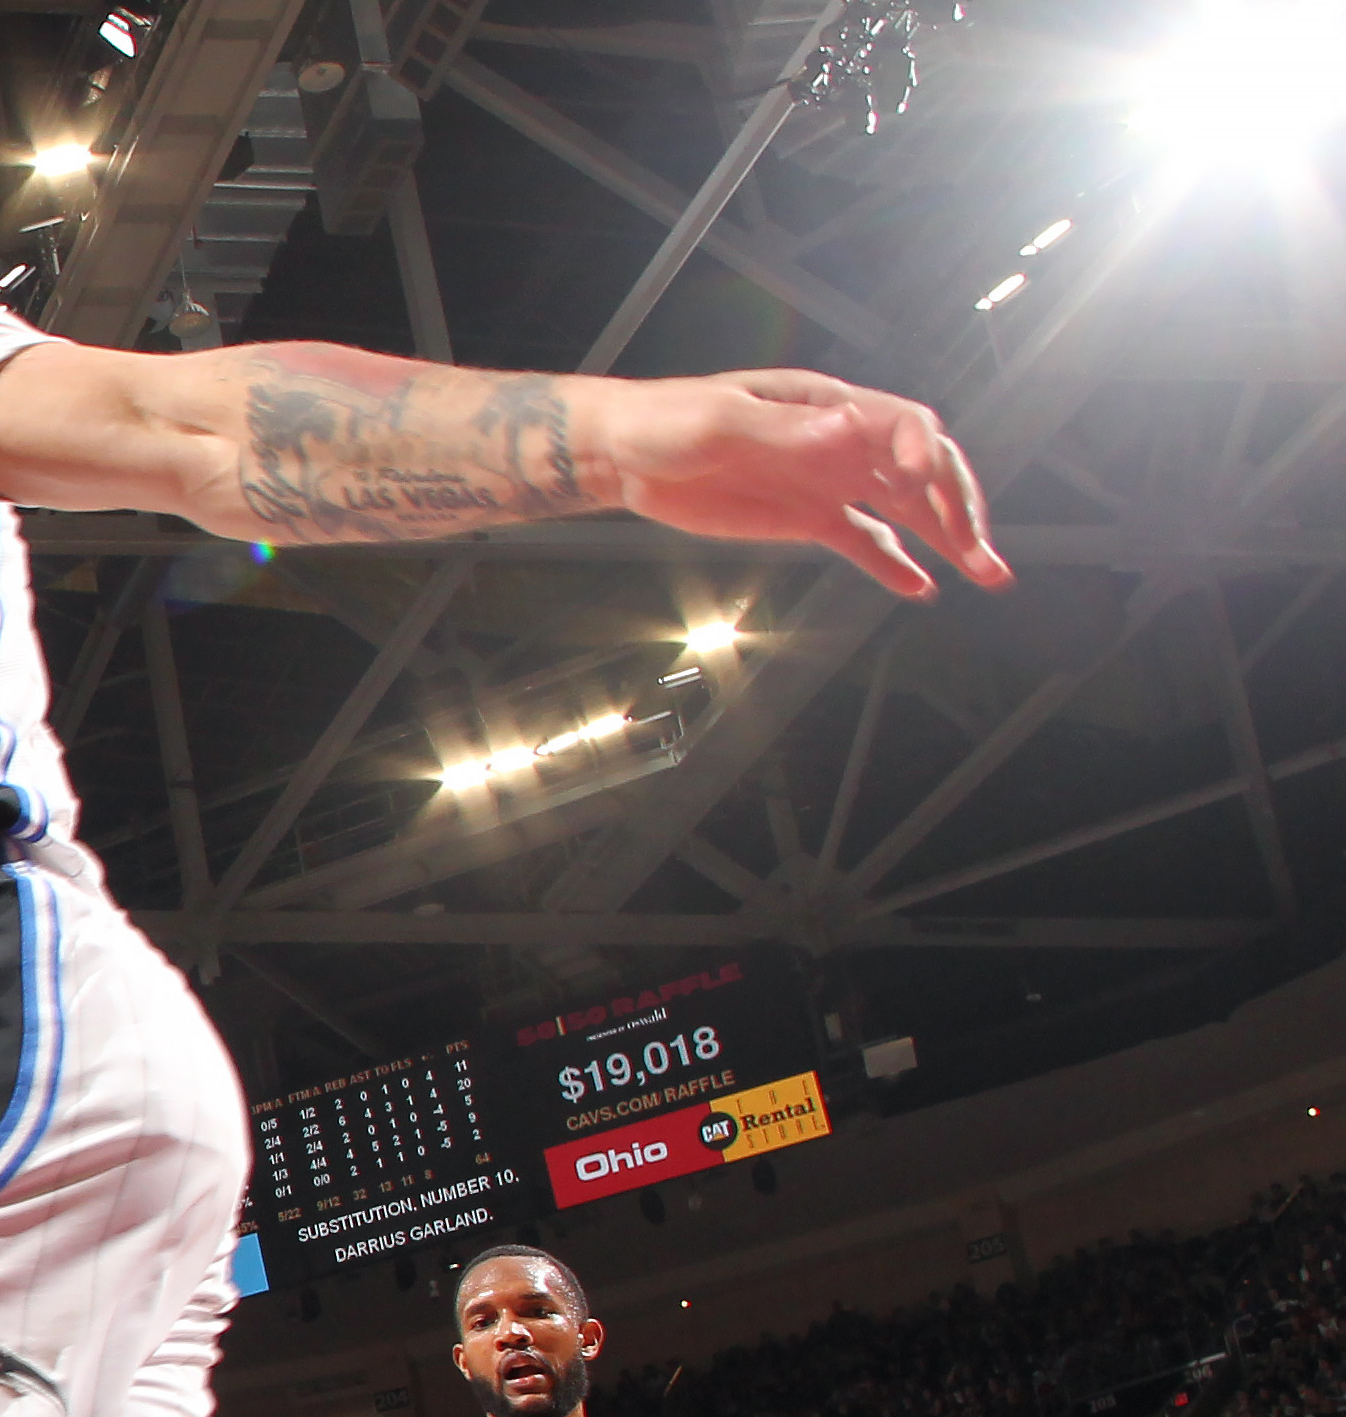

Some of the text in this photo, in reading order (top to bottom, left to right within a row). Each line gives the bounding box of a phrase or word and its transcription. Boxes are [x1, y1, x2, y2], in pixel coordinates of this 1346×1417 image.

[260, 1060, 468, 1133] 0/5 1/2 2 0 1 0 4 11
[350, 1070, 372, 1085] AST
[446, 1039, 470, 1054] PTS
[558, 1025, 721, 1103] $19,018
[264, 1078, 472, 1150] 2/4 2/2 6 4 3 1 4 20
[268, 1095, 472, 1165] 1/1 2/4 2 0 1 0 5
[272, 1112, 476, 1181] 1/3 4/4 4 5 2 1 9
[575, 1098, 818, 1182] Ohio CAT Rental
[275, 1129, 482, 1198] 0/1 0/0 2 1 1 0 2
[298, 1169, 519, 1242] SUBSTITUTION. NUMBER 10.
[334, 1208, 494, 1262] DARRIUS GARLAND.
